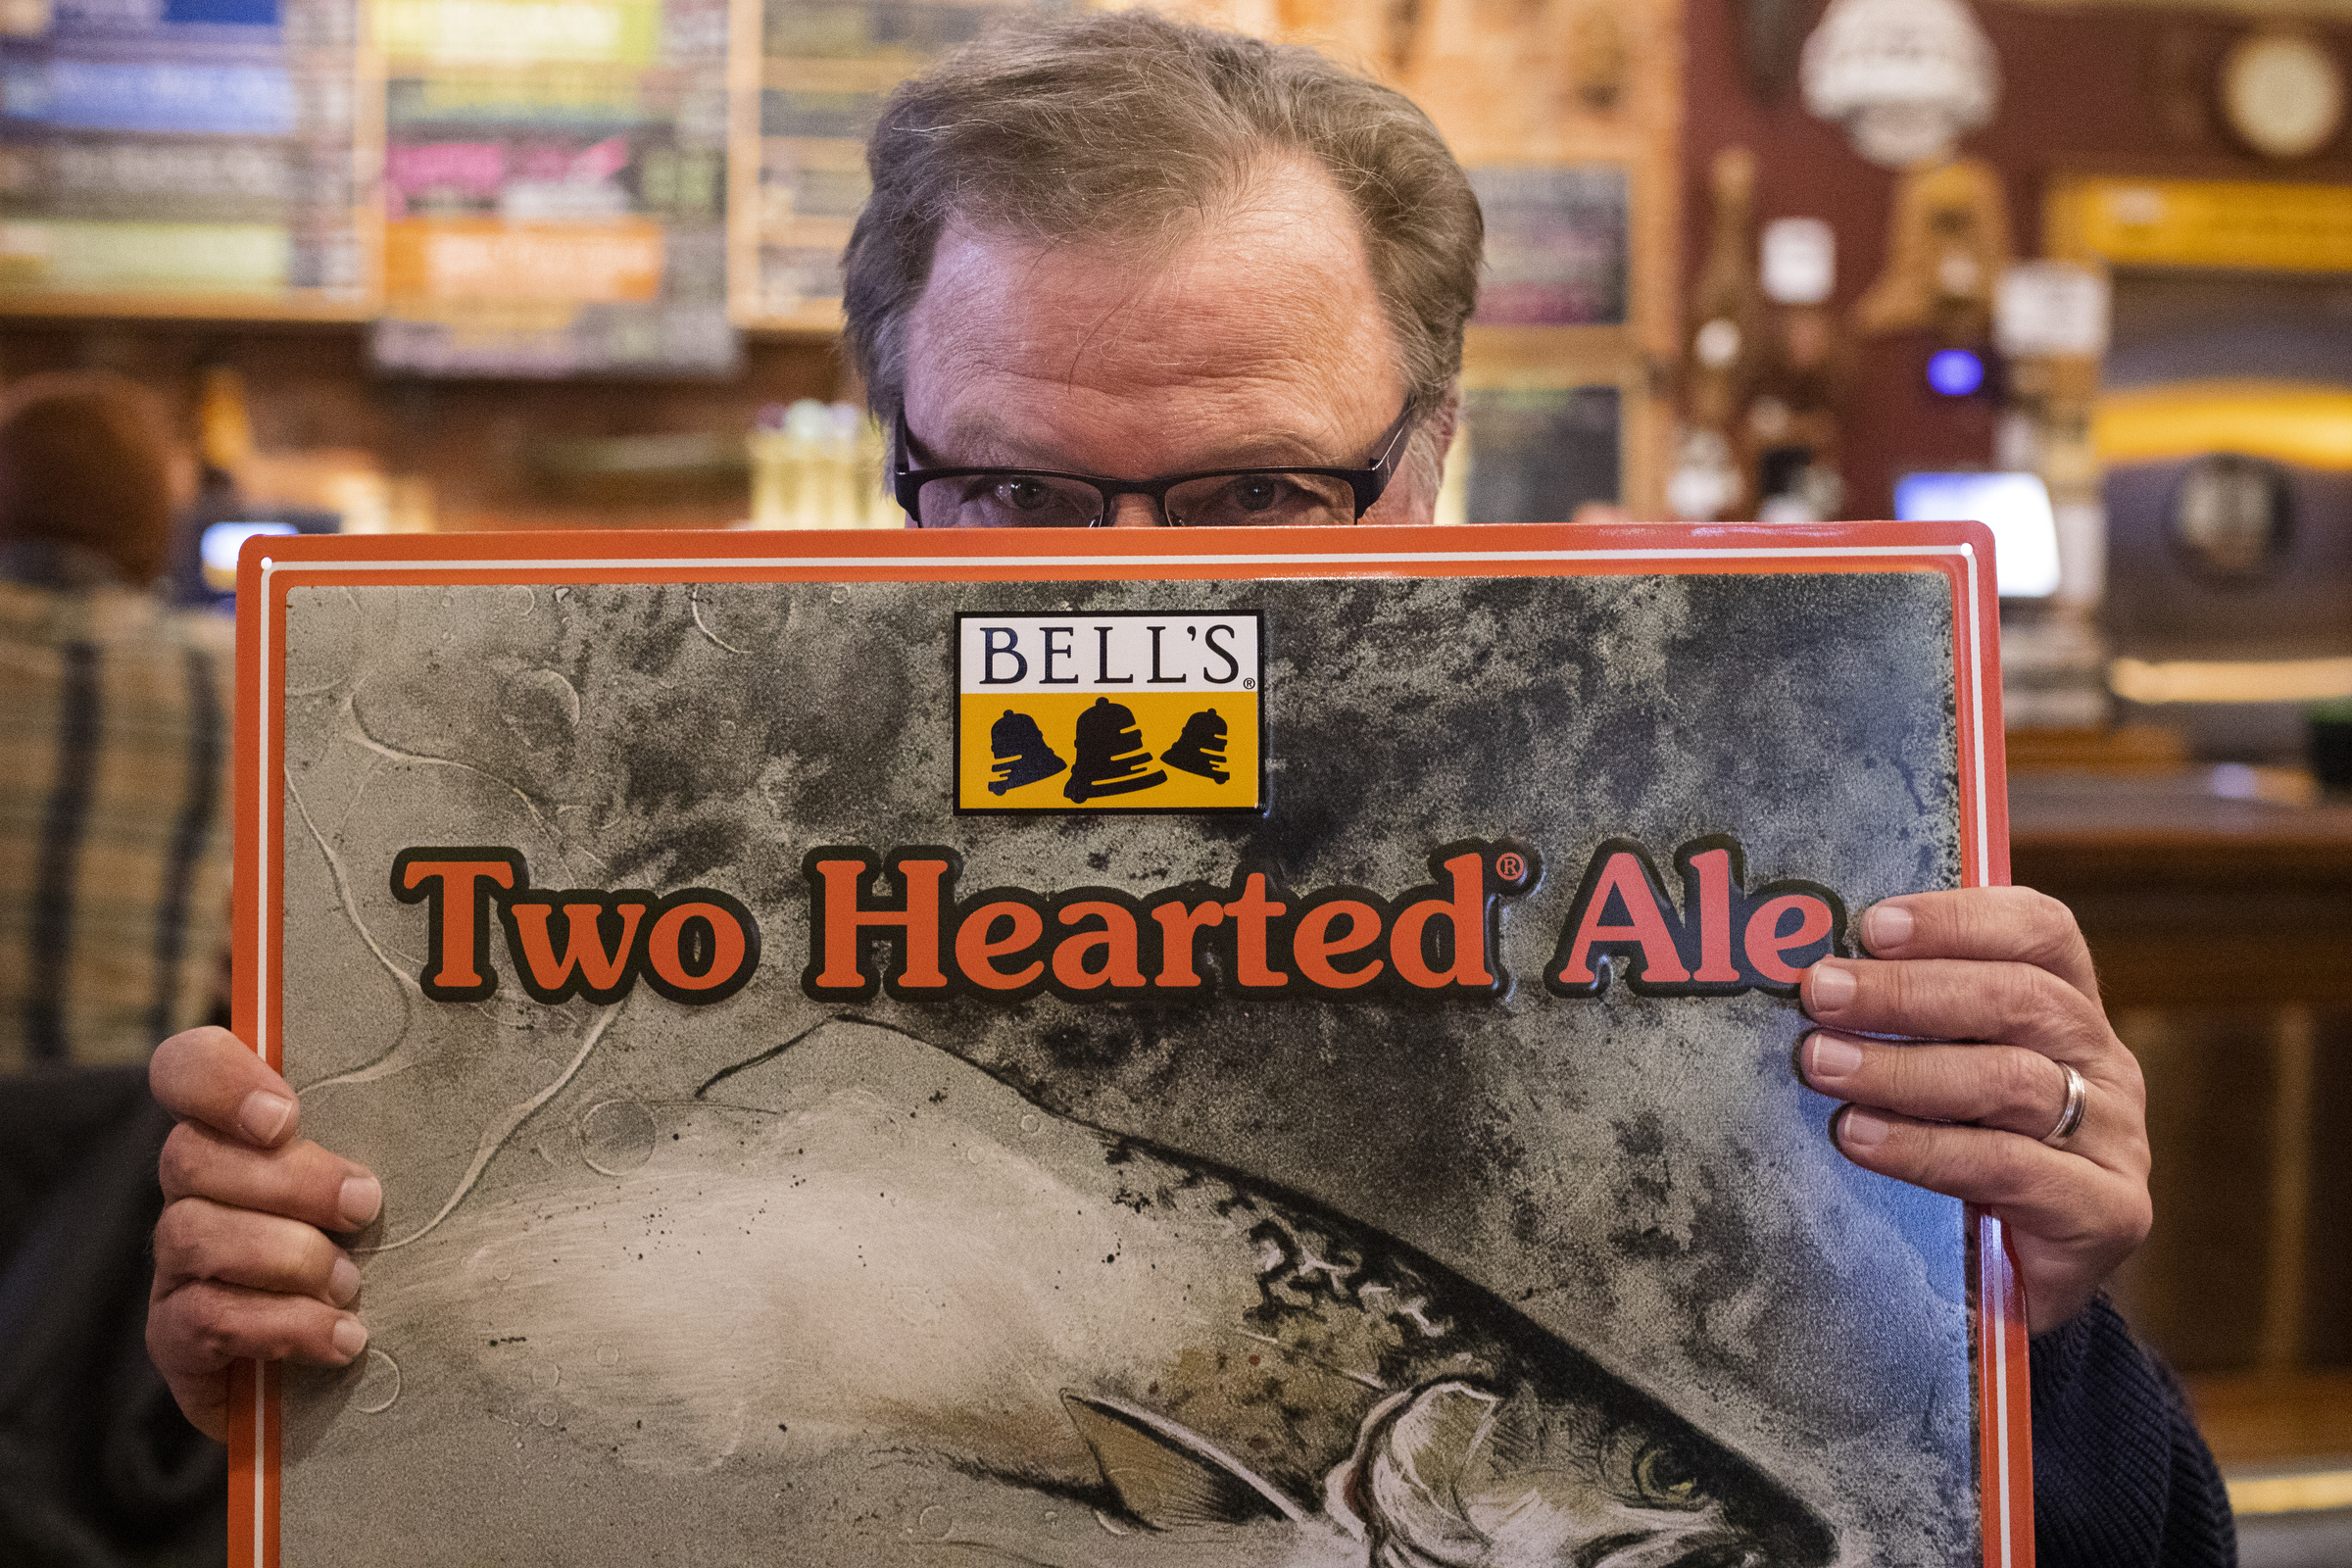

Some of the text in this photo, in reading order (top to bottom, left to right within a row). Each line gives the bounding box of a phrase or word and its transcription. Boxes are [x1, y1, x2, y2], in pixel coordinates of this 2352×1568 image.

[403, 851, 1835, 991] Two Hearted Ale
